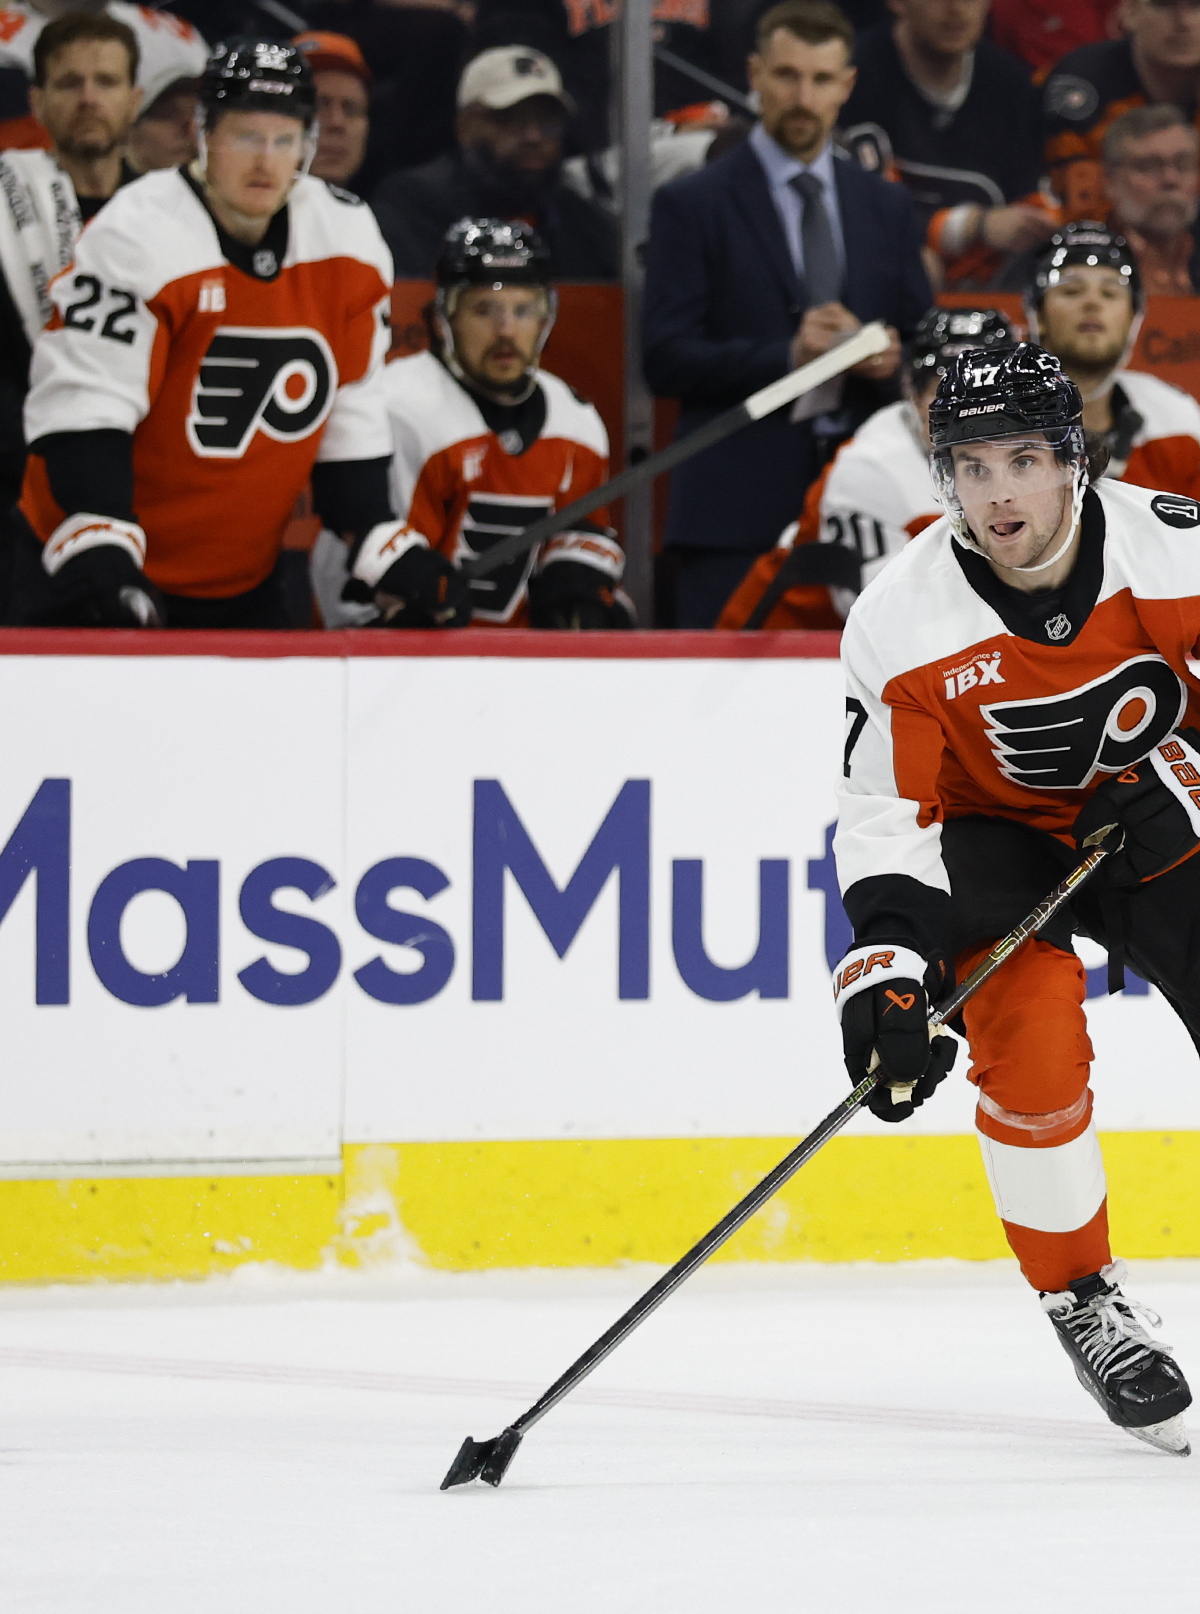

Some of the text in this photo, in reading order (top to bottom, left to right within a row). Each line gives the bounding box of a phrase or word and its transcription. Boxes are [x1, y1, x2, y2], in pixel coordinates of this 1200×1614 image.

[65, 274, 137, 344] 22
[971, 366, 1000, 388] 17
[958, 402, 1006, 418] BAUER
[944, 659, 1006, 700] IBX
